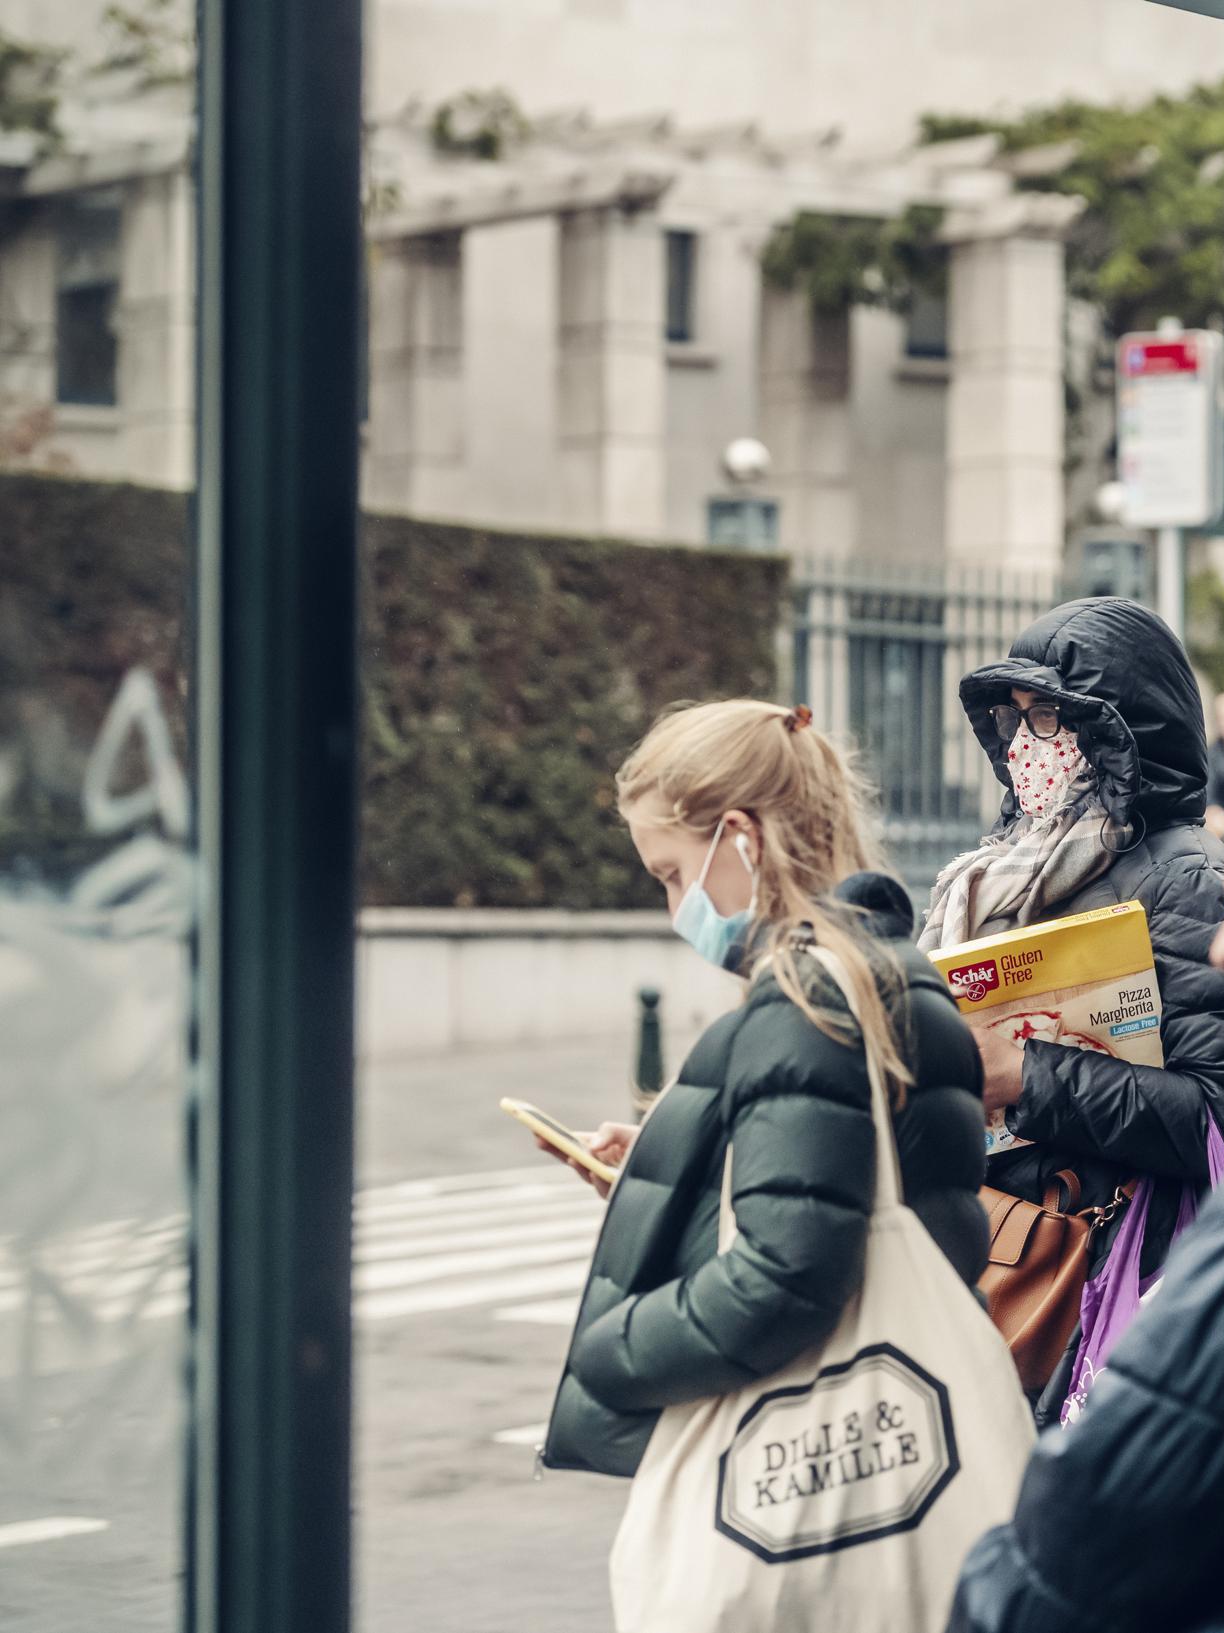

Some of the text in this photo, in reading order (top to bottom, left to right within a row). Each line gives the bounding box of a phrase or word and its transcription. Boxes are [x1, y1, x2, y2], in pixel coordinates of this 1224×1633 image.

[1000, 949, 1043, 971] Gluten
[951, 966, 995, 987] Schär
[1003, 968, 1033, 987] Free
[1118, 987, 1152, 1005] Pizza
[1089, 1001, 1154, 1026] Margherita
[1113, 1018, 1157, 1035] Lactose Free
[764, 1400, 904, 1473] DILLE &
[754, 1432, 920, 1509] KAMILLE
